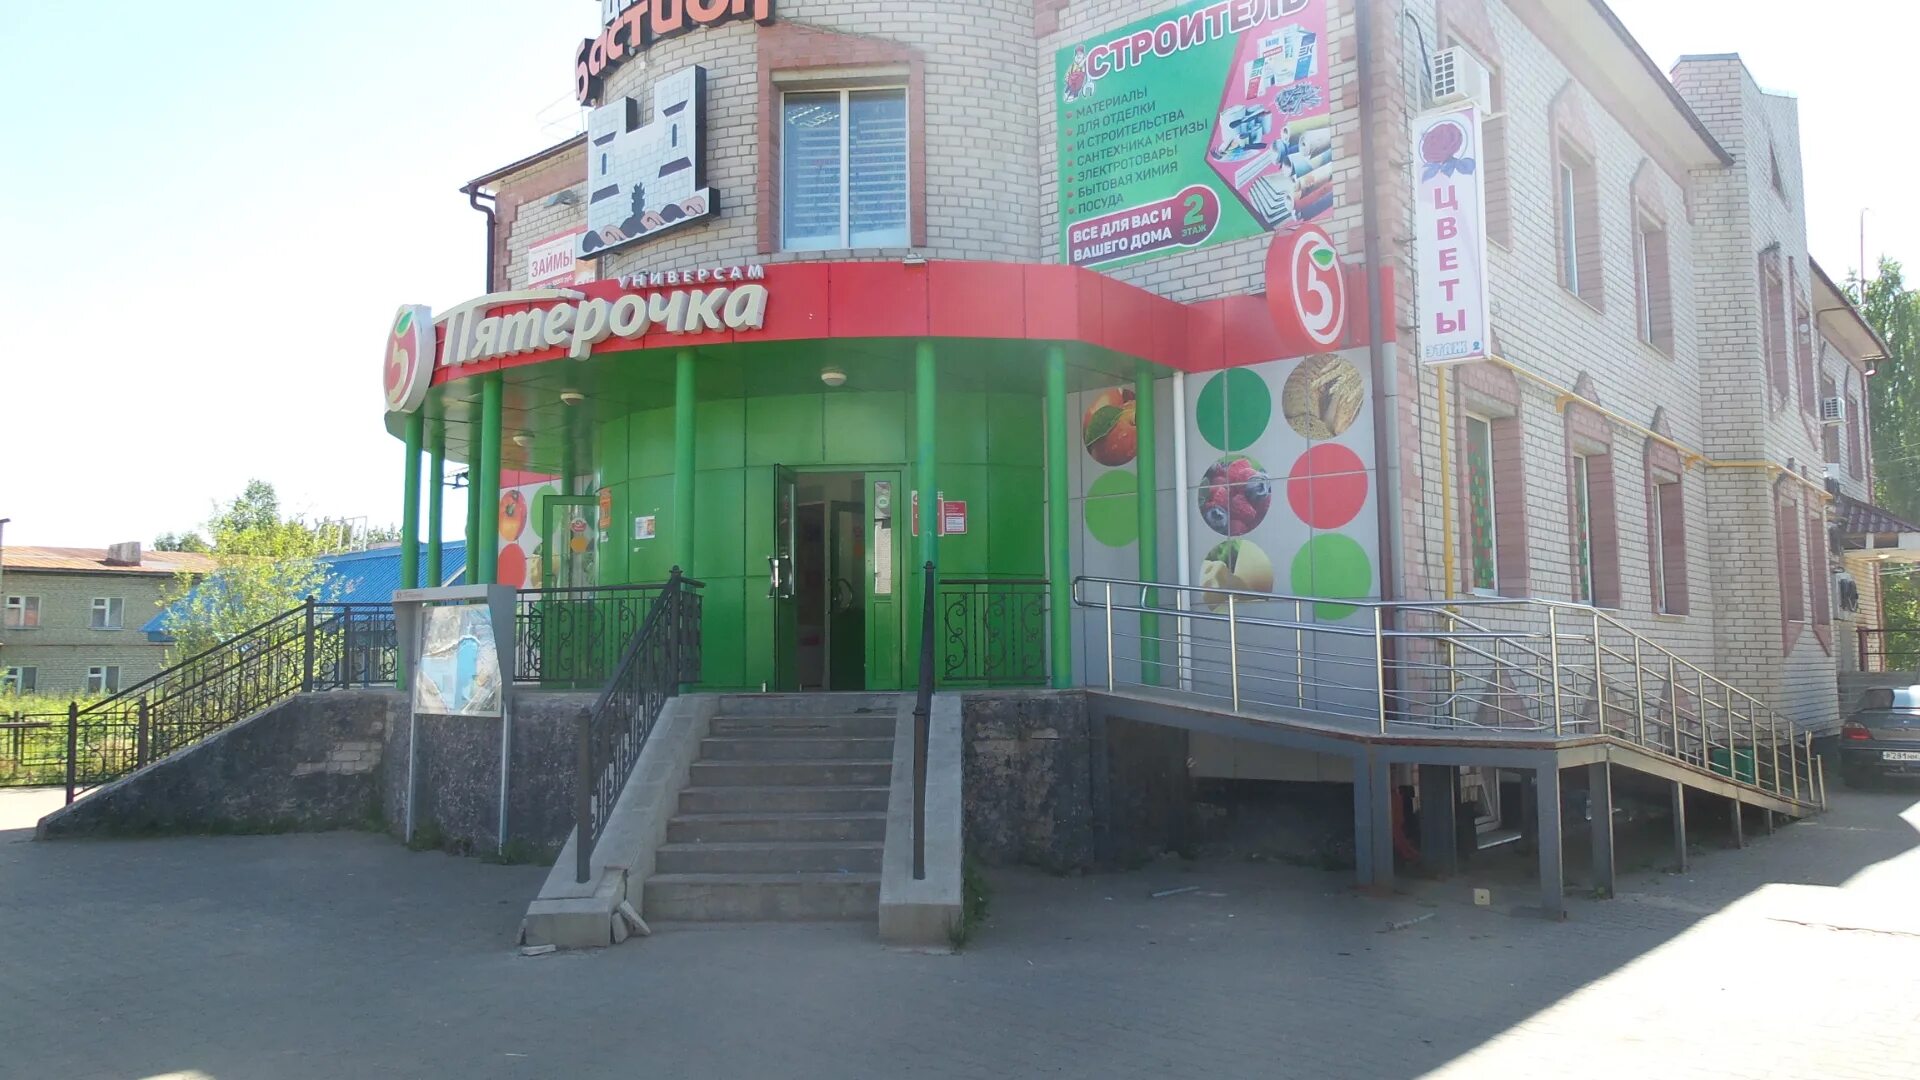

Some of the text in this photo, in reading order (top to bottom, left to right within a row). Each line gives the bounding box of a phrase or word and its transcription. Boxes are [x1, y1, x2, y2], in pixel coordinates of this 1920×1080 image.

[1076, 87, 1148, 119] МАТЕРИАЛЫ
[1076, 101, 1156, 137] ДЛЯ ОТДЕЛКИ
[1076, 108, 1185, 151] И СТРОИТЕЛЬСТВА
[1077, 118, 1208, 167] САНТЕХНИКА МЕТИЗЫ
[1078, 145, 1178, 182] ЭЛЕКТРОТОВАРЫ
[1078, 160, 1179, 199] БЫТОВАЯ ХИМИЯ
[1078, 193, 1124, 214] ПОСУДА
[1183, 193, 1205, 227] 2
[1073, 206, 1172, 244] ВСЕ ДЛЯ ВАС И
[1181, 224, 1207, 238] ЭТАЖ
[1073, 227, 1173, 262] ВАШЕГО ДОМА
[1434, 185, 1466, 335] ЦВЕТЫ
[531, 248, 573, 278] ЗАЙМЫ
[617, 264, 765, 289] УНИВЕРСАМ
[433, 284, 768, 361] Пятерочка
[1472, 341, 1482, 351] 2
